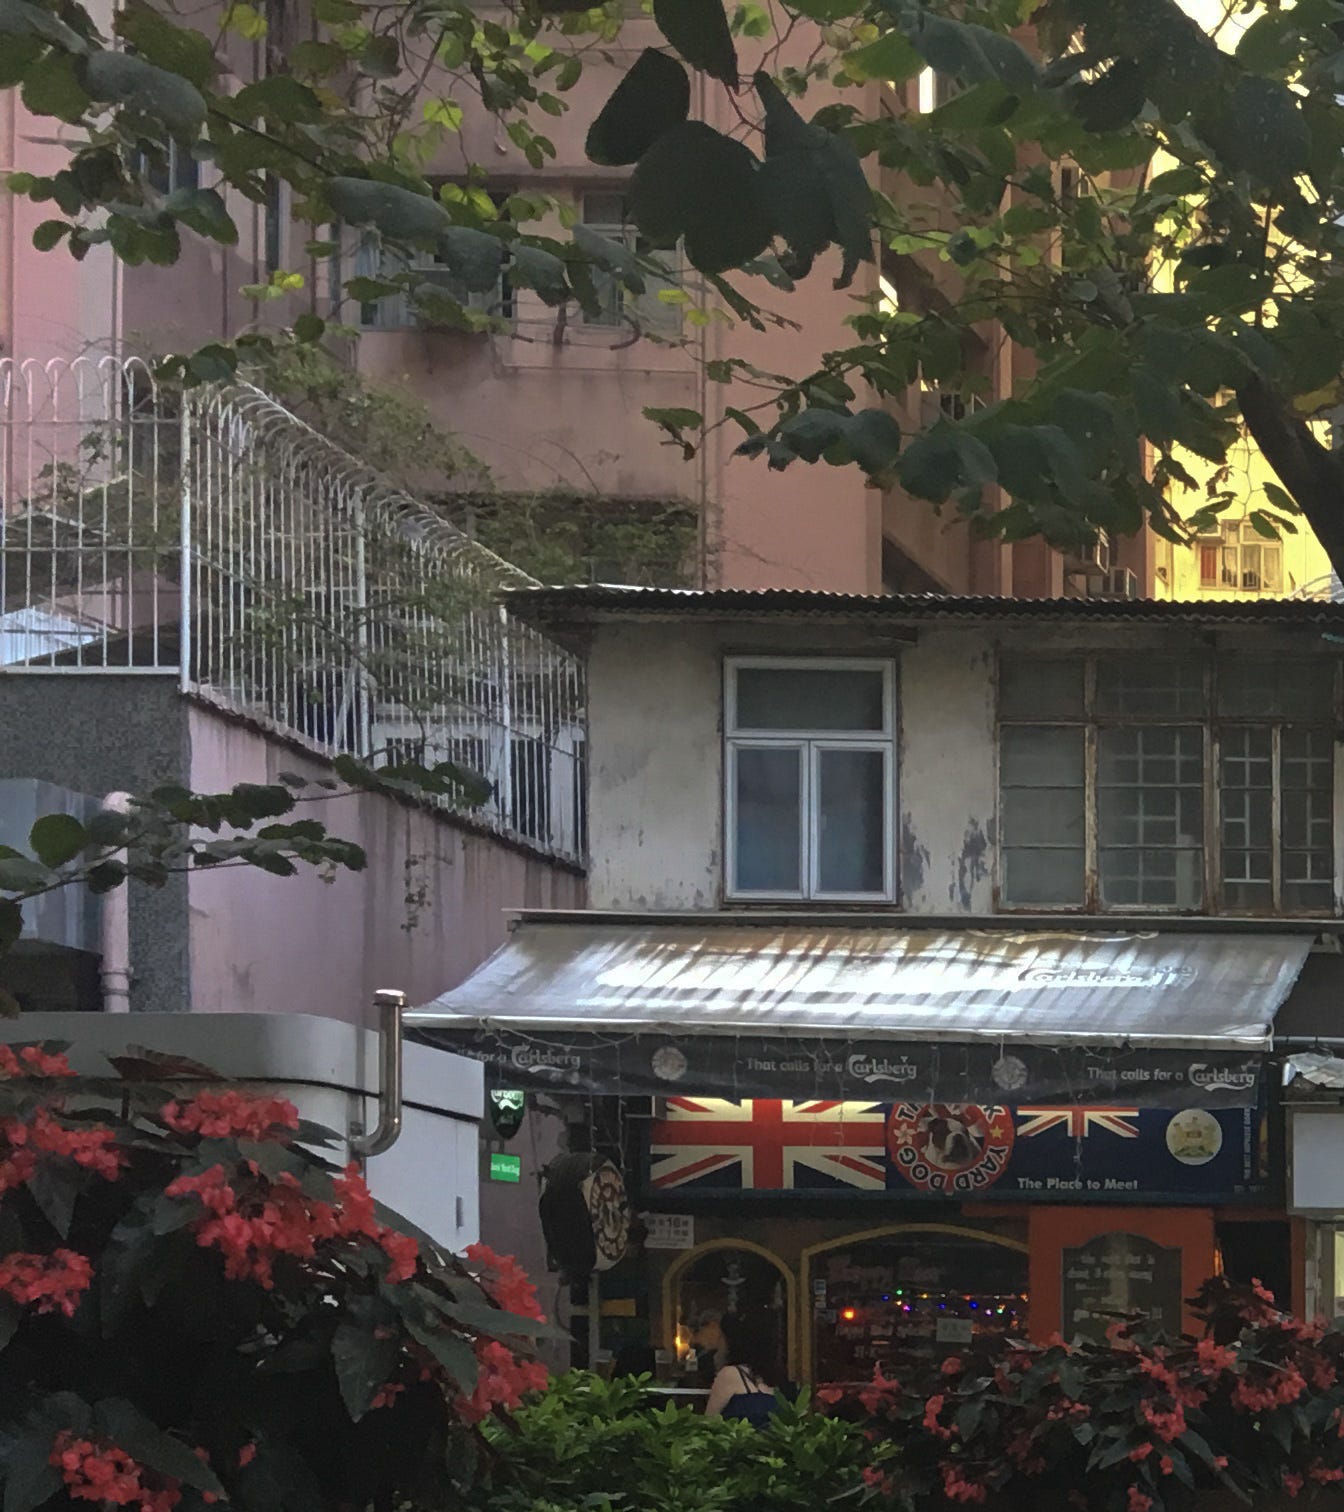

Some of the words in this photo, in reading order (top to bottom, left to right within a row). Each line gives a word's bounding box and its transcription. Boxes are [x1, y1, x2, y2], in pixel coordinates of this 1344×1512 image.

[511, 1044, 581, 1072] Carlsberg
[747, 1058, 777, 1071] That
[780, 1059, 810, 1072] calls
[814, 1059, 835, 1072] for
[848, 1054, 917, 1082] Carlsberg
[1088, 1067, 1117, 1081] That
[1121, 1067, 1150, 1081] calls
[1154, 1067, 1172, 1081] for
[1188, 1063, 1256, 1091] Carlsberg
[898, 1144, 947, 1190] DOG
[954, 1145, 1008, 1190] YARD
[1017, 1177, 1043, 1190] The
[1047, 1177, 1083, 1190] Place
[1087, 1178, 1100, 1190] to
[1103, 1177, 1138, 1190] Meet
